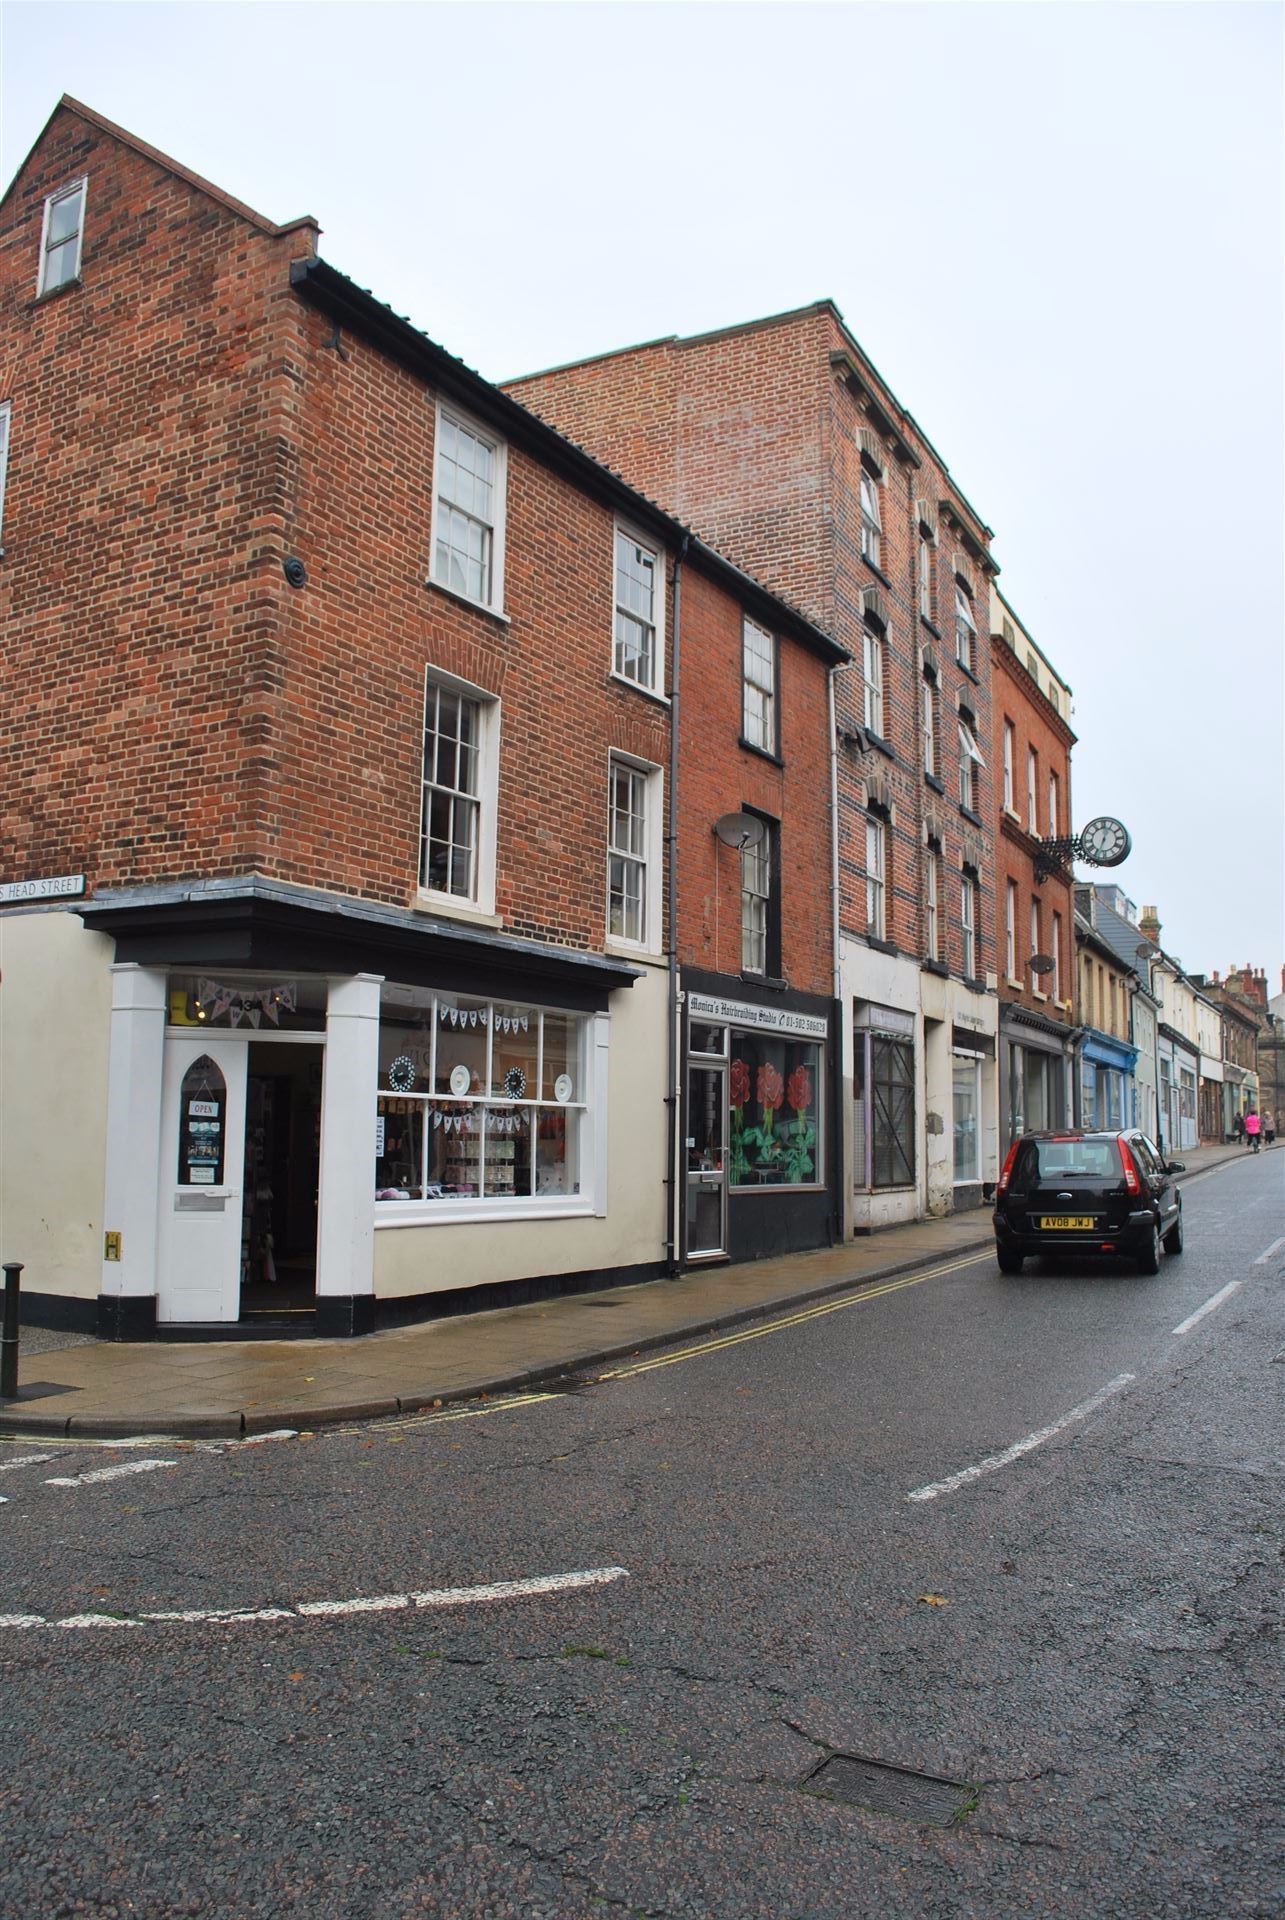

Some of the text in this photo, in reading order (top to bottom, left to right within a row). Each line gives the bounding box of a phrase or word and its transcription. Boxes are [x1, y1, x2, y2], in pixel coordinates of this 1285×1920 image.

[9, 882, 36, 898] HEAD
[41, 877, 81, 894] STREET
[690, 997, 719, 1014] Monica's
[759, 1009, 777, 1025] Studio
[194, 1104, 213, 1114] OPEN
[1045, 1217, 1091, 1227] AV08 JWJ
